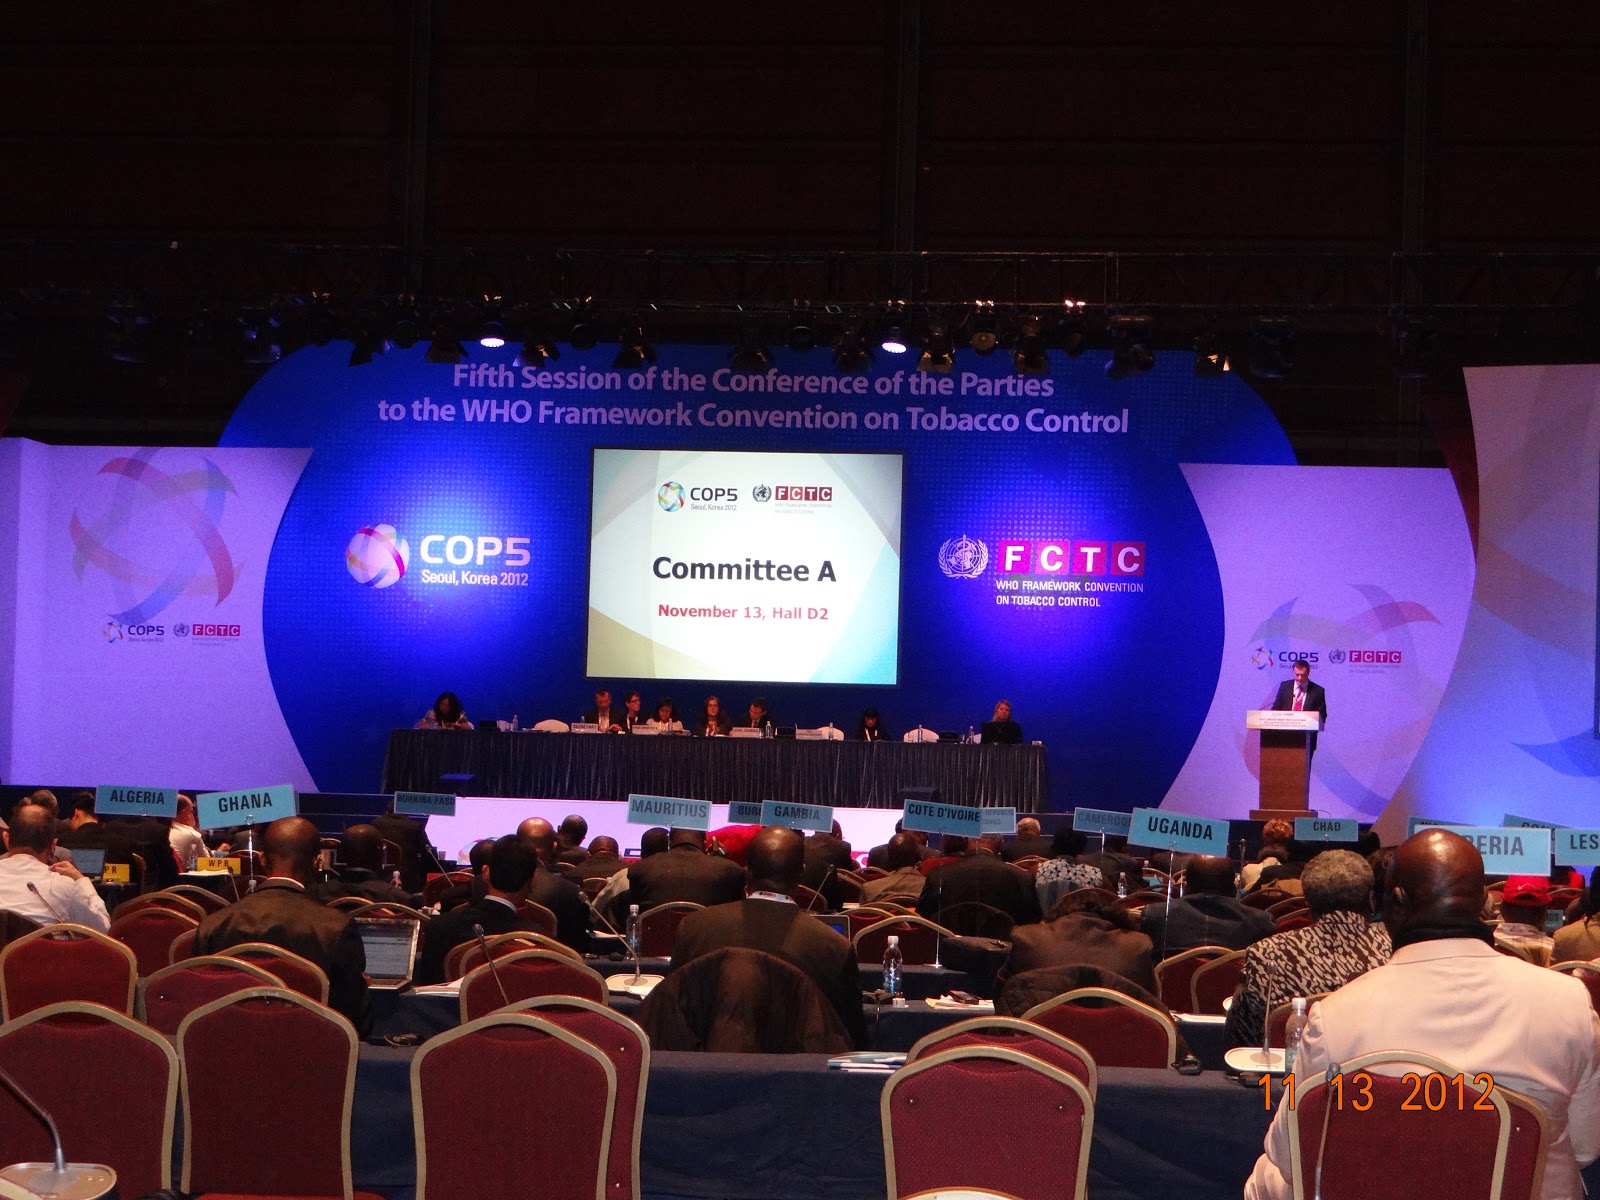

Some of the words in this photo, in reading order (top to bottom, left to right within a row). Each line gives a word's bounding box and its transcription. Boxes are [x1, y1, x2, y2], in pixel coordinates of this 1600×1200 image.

[453, 363, 514, 388] Fifth
[521, 366, 621, 390] Session
[628, 366, 656, 390] of
[661, 368, 706, 391] the
[712, 368, 868, 395] Conference
[875, 370, 904, 395] of
[909, 371, 954, 395] the
[961, 372, 1054, 397] Parties
[378, 400, 406, 421] to
[411, 397, 456, 422] the
[462, 399, 532, 424] WHO
[538, 401, 692, 427] Framework
[698, 402, 857, 429] Convention
[864, 408, 899, 430] on
[906, 406, 1020, 432] Tobacco
[1025, 408, 1129, 433] Control
[690, 487, 738, 502] COP5
[777, 487, 832, 501] FCTC
[724, 504, 738, 512] 2012
[420, 535, 531, 567] COP5
[1004, 544, 1141, 573] FCTC
[653, 556, 810, 582] Committee
[817, 560, 837, 582] A
[421, 569, 460, 586] Seoul,
[461, 571, 498, 586] Korea
[500, 572, 529, 586] 2012
[996, 580, 1018, 591] WHO
[1022, 581, 1081, 592] FRAMEWORK
[1085, 582, 1144, 593] CONVENTION
[996, 595, 1009, 605] ON
[1012, 595, 1055, 606] TOBACCO
[1058, 597, 1101, 608] CONTROL
[658, 604, 738, 618] November
[744, 606, 767, 621] 13,
[773, 607, 802, 619] Hall
[807, 608, 829, 620] D2
[127, 625, 165, 636] COP5
[194, 625, 239, 636] FCTC
[1278, 651, 1319, 663] COP5
[1351, 651, 1400, 662] FCTC
[110, 789, 165, 805] ALGERIA
[218, 792, 273, 813] GHANA
[631, 799, 707, 818] MAURITIUS
[774, 806, 821, 820] GAMBIA
[908, 803, 935, 816] COTE
[937, 807, 980, 823] D'IVOIRE
[1147, 816, 1214, 841] UGANDA
[1313, 821, 1341, 832] CHAD
[104, 866, 117, 875] PR
[208, 859, 230, 868] WPR
